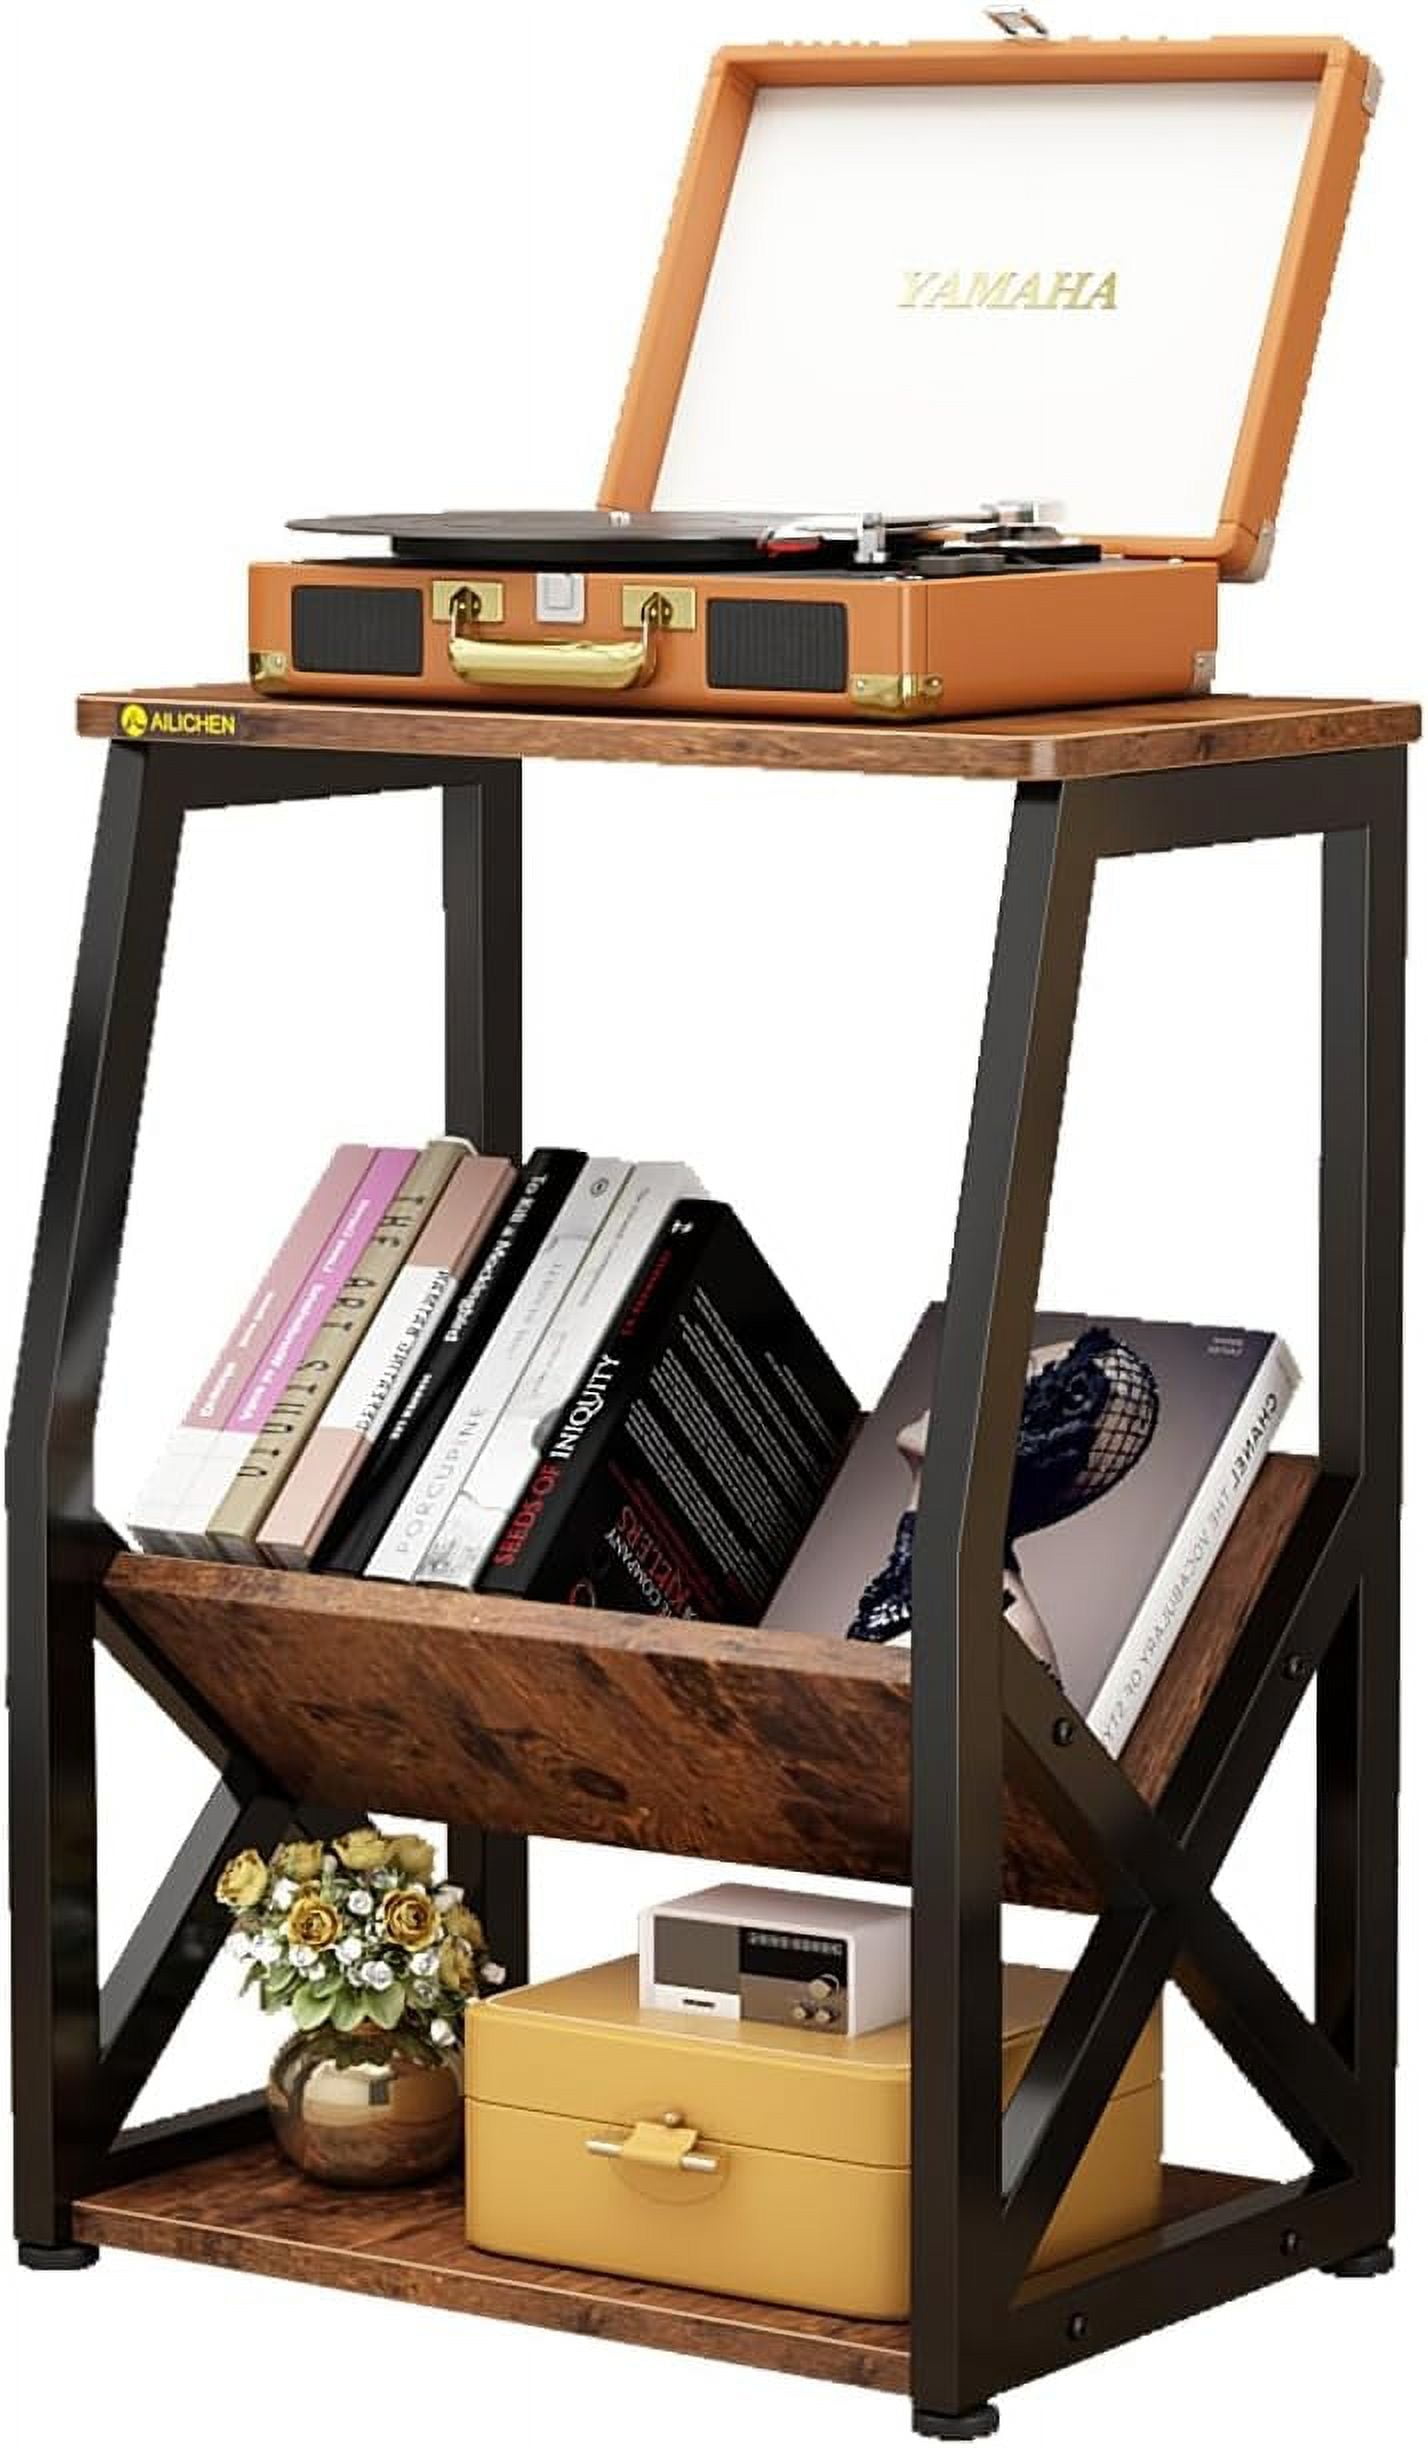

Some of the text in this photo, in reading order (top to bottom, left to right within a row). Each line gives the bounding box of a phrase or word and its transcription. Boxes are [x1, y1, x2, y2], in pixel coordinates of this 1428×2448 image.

[897, 271, 1118, 309] YAMAHA
[150, 711, 235, 735] AILICHEN
[372, 1194, 425, 1248] THE
[320, 1275, 378, 1332] ART
[237, 1359, 330, 1479] STUDIO
[397, 1407, 484, 1552] PORCUPINE
[493, 1499, 545, 1567] SEEDS
[532, 1463, 562, 1496] OF
[549, 1353, 621, 1460] INIQUITY
